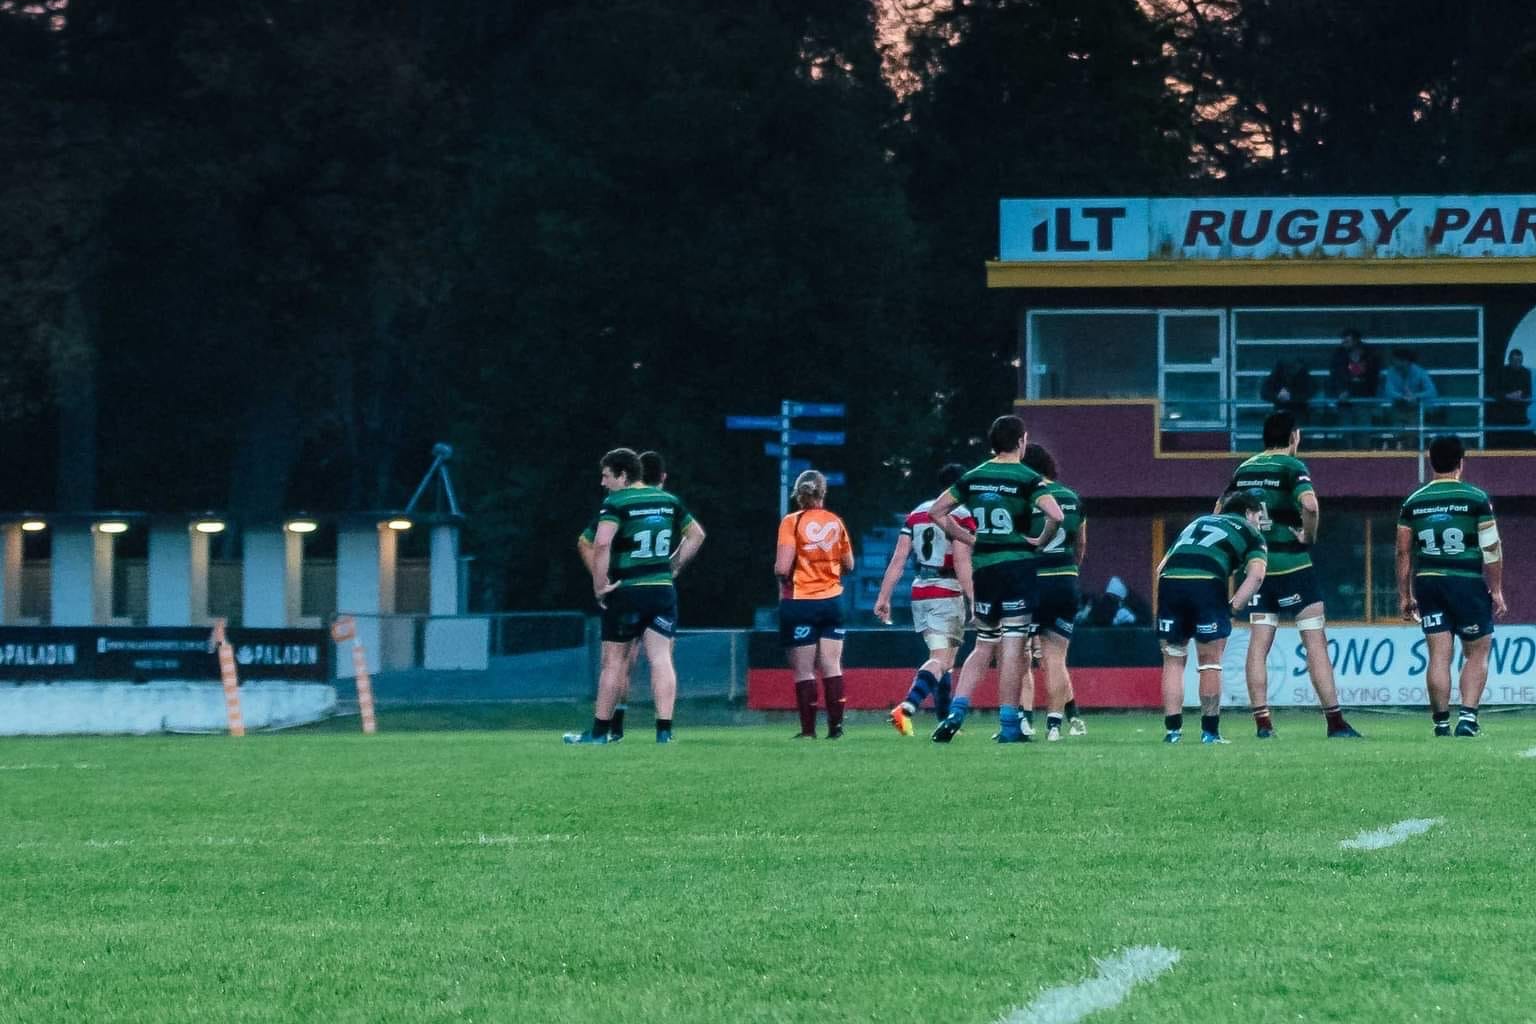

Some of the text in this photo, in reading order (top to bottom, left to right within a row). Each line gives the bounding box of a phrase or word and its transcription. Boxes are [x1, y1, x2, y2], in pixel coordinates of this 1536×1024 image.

[1182, 207, 1412, 248] RUGBY
[973, 507, 1014, 535] 19
[630, 529, 672, 558] 16
[1175, 523, 1228, 548] 17
[1418, 528, 1465, 555] 18
[1408, 638, 1536, 676] SND
[1293, 687, 1392, 703] SULYING
[1398, 687, 1461, 702] SOD
[1500, 686, 1536, 702] THE
